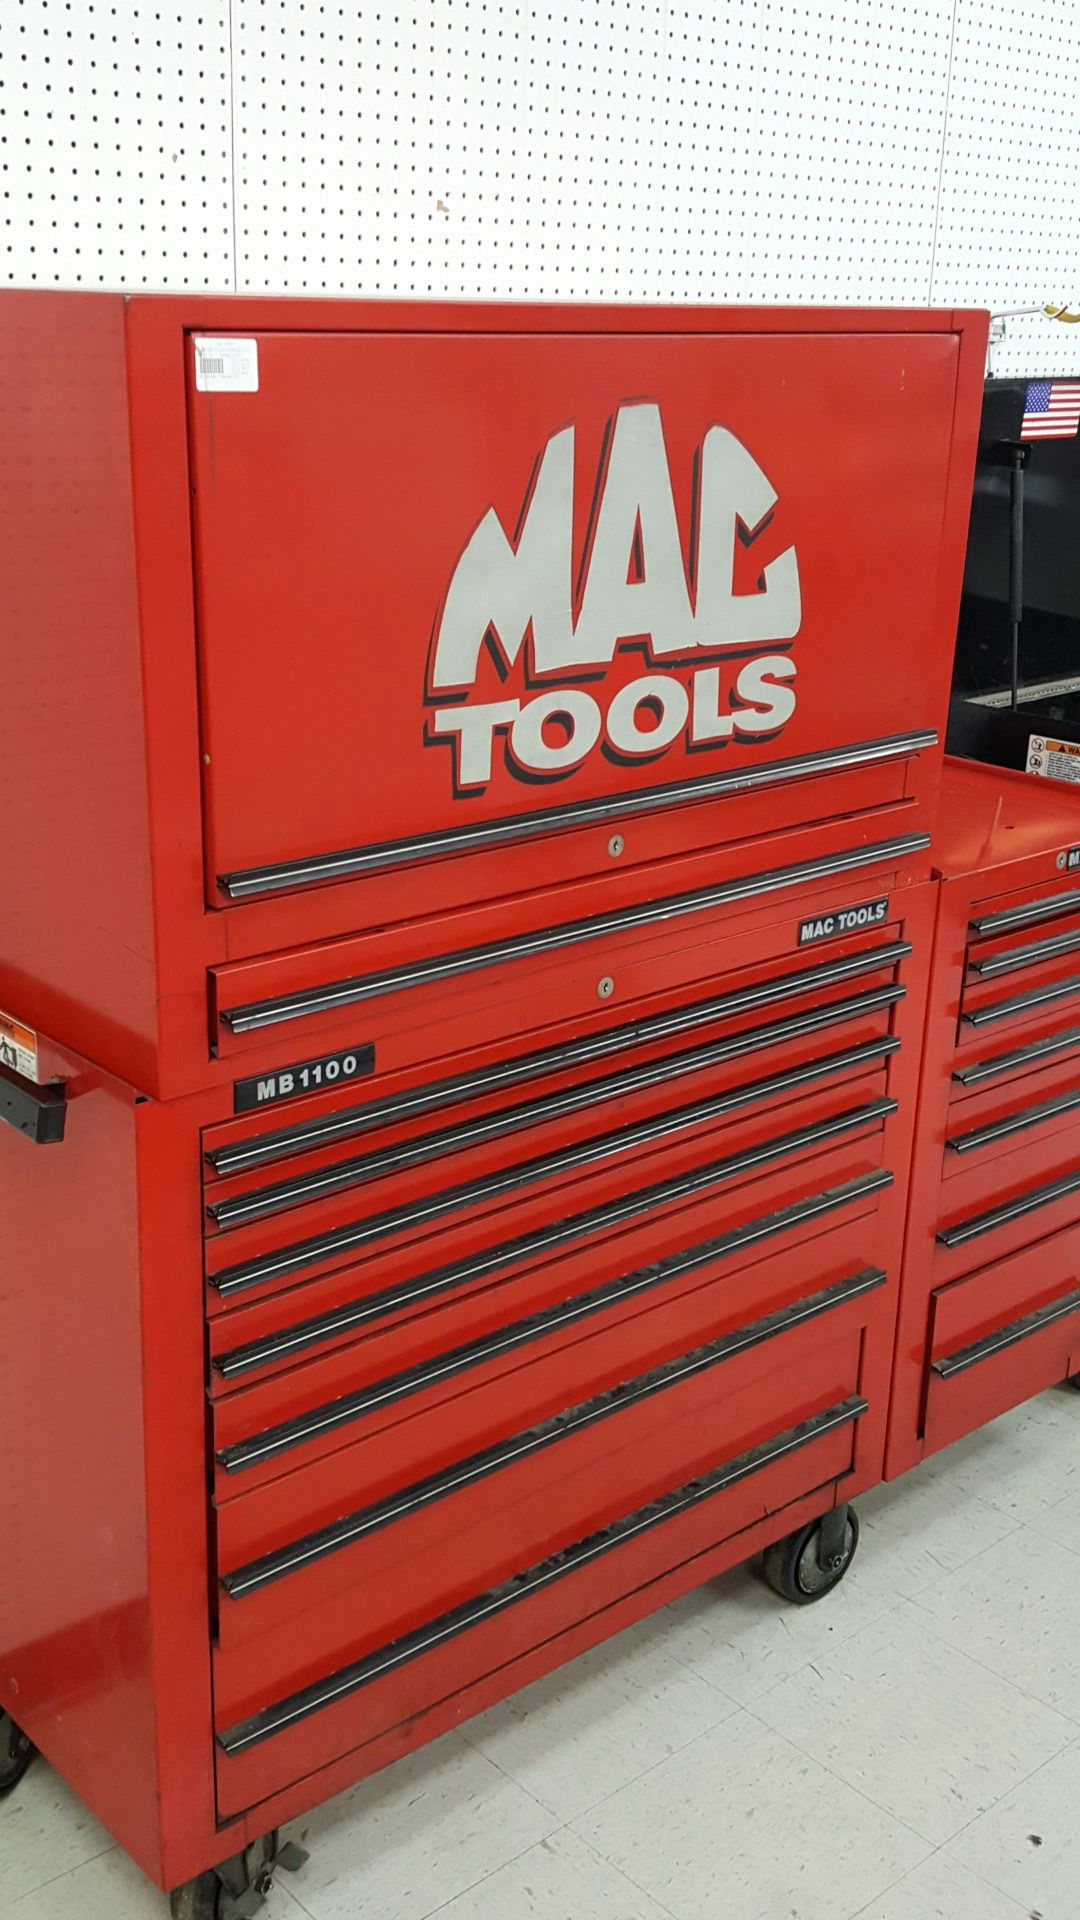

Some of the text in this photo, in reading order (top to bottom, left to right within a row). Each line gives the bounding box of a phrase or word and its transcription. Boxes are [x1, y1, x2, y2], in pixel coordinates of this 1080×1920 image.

[431, 402, 802, 689] MAC
[433, 655, 798, 786] TOOLS
[801, 903, 885, 941] MAC TOOLS
